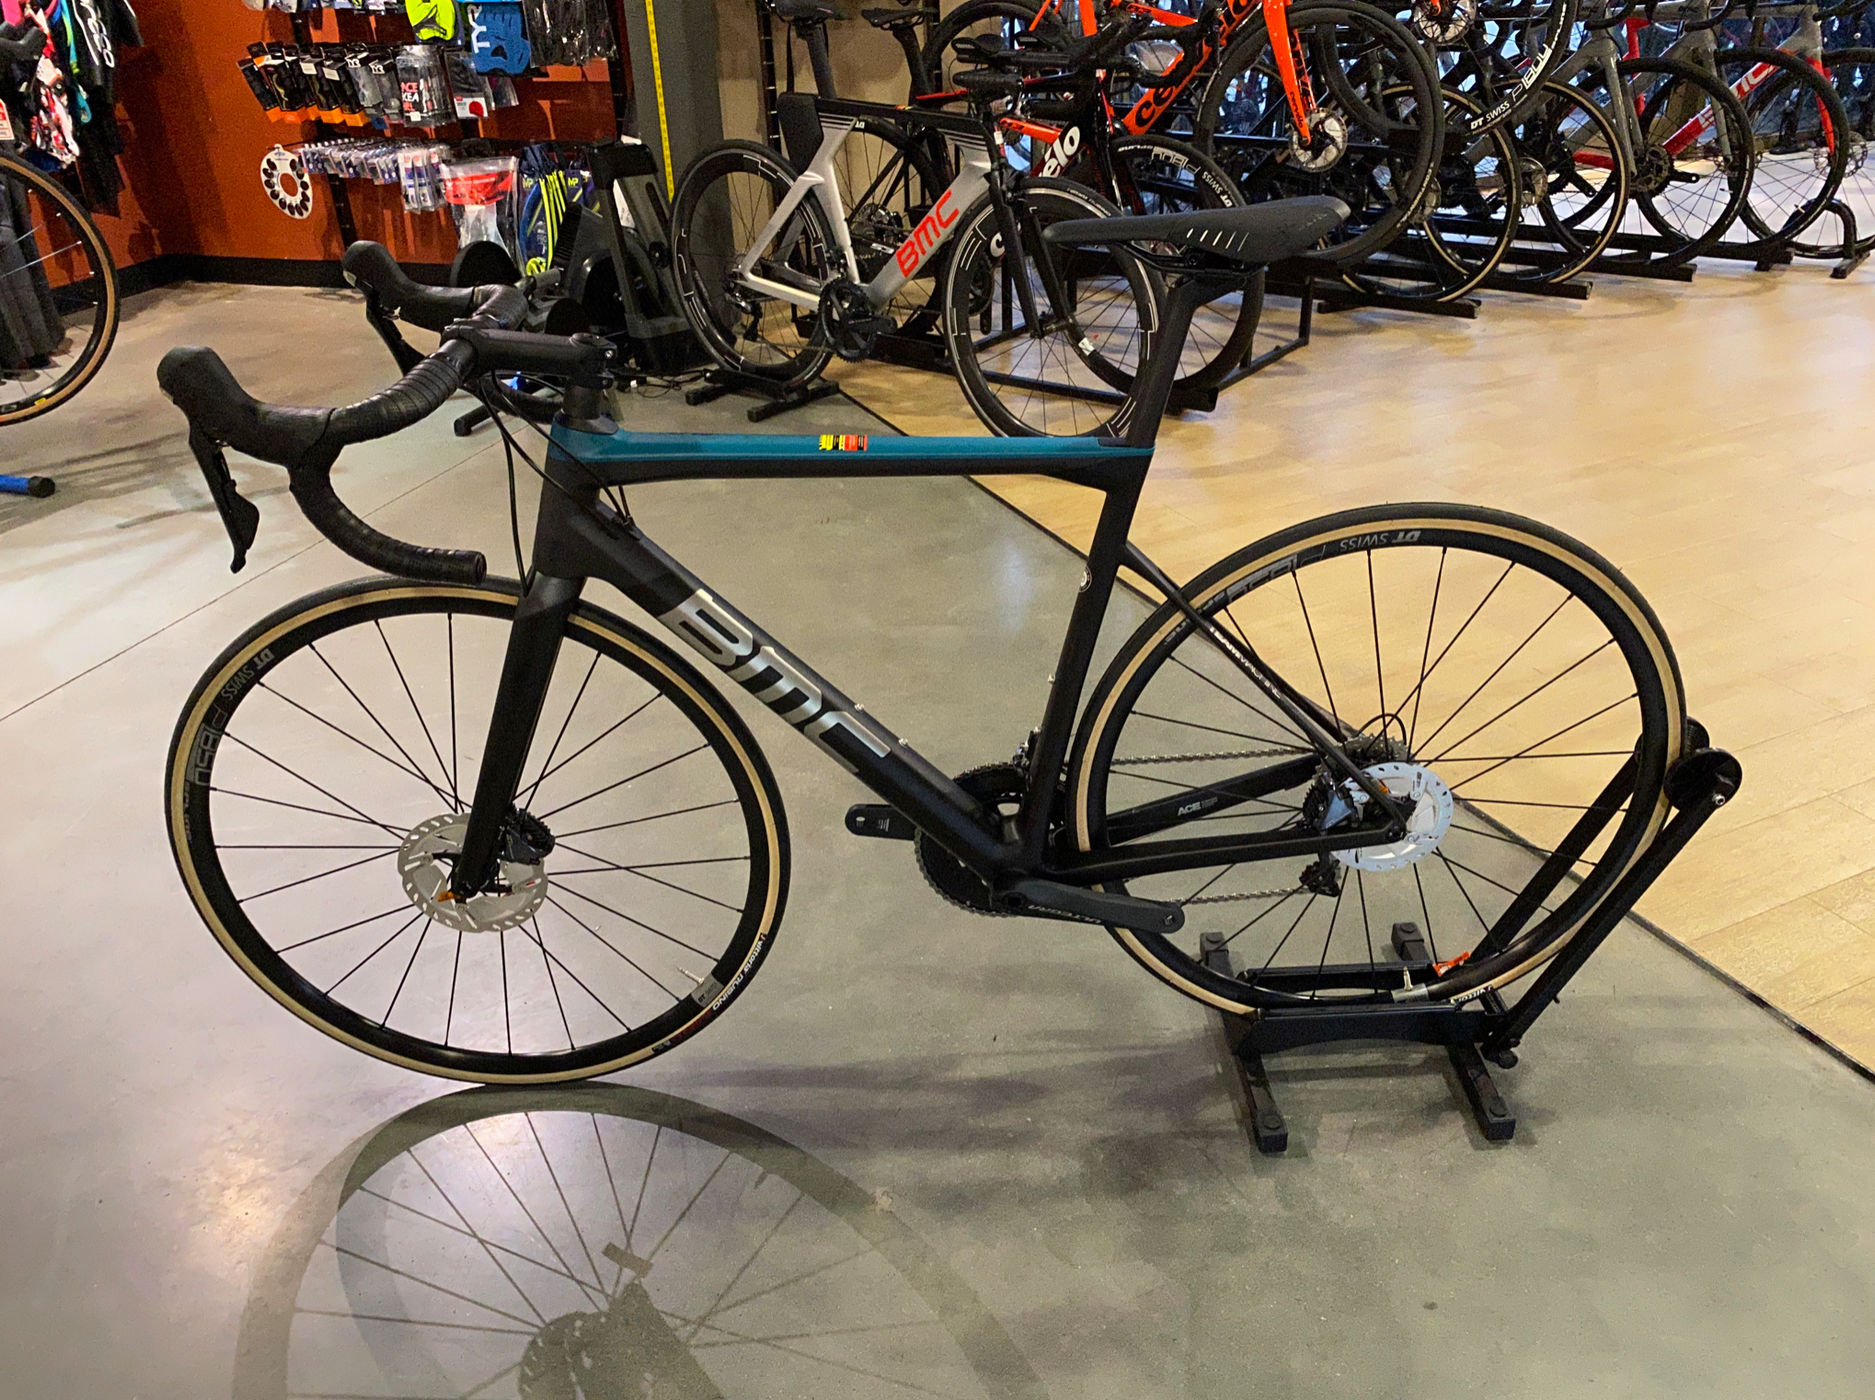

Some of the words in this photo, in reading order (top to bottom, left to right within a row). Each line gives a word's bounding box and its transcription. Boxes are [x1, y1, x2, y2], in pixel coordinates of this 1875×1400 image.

[467, 4, 490, 53] TYR
[1470, 116, 1485, 130] DT
[1485, 100, 1511, 122] SWISS
[1201, 171, 1224, 195] SWISS
[1219, 194, 1234, 208] DT
[895, 188, 960, 278] BMC
[1339, 532, 1389, 551] SWISS
[1392, 530, 1422, 544] DT
[253, 648, 275, 670] DT
[221, 664, 255, 701] SWISS
[656, 588, 892, 773] BMC
[1177, 801, 1201, 816] ACE
[712, 973, 744, 1011] RUBINO
